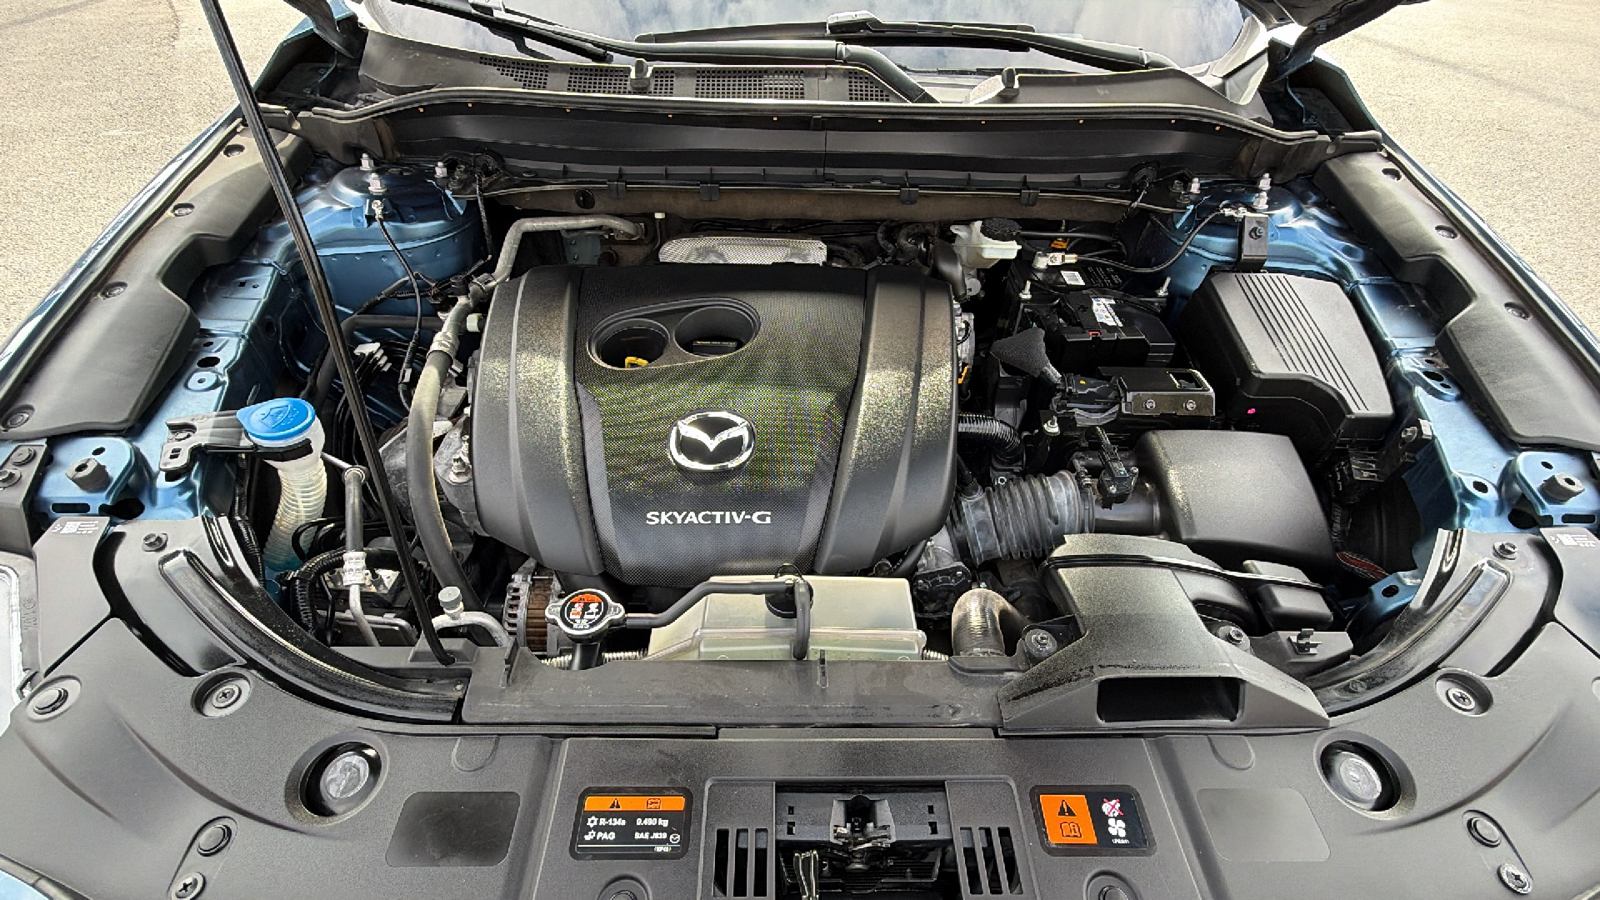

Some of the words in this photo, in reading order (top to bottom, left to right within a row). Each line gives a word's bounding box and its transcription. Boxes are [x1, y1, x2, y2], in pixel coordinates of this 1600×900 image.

[646, 511, 771, 525] SKYACTIV-G
[599, 818, 626, 826] R-134a
[658, 818, 669, 828] kg
[596, 832, 616, 840] PAG
